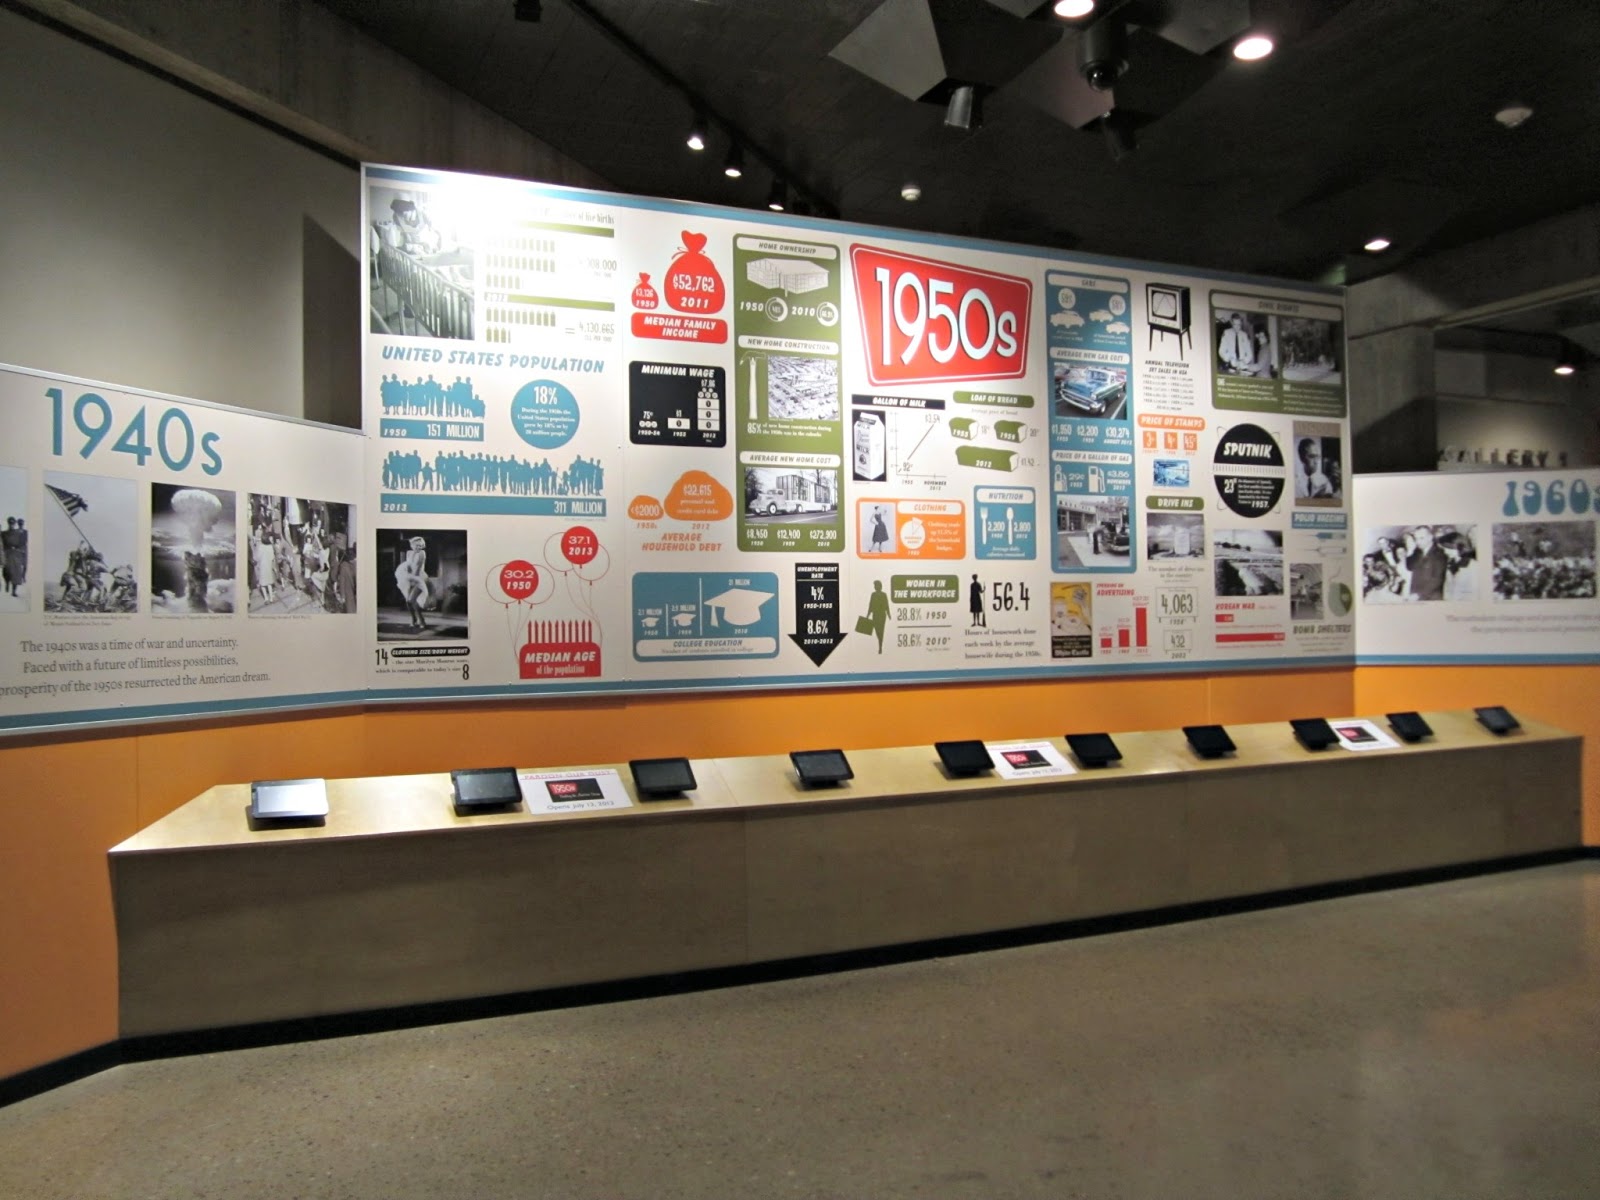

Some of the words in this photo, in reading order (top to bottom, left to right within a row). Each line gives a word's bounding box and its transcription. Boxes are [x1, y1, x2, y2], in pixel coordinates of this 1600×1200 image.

[597, 213, 614, 224] births
[759, 243, 777, 251] HOME
[780, 245, 816, 254] OWNERSHIP
[672, 274, 715, 293] $52,762
[635, 300, 655, 308] 1950
[681, 297, 709, 309] 2011
[740, 301, 764, 311] 1950
[791, 306, 816, 316] 2010
[875, 266, 1018, 366] 1950s
[644, 316, 682, 328] MEDIAN
[683, 319, 716, 330] FAMILY
[662, 328, 699, 339] INCOME
[784, 341, 830, 350] CONSTRUCTION
[382, 345, 443, 363] UNITED
[448, 350, 504, 367] STATES
[509, 355, 605, 373] POPULATION
[641, 365, 687, 376] MINIMUM
[689, 368, 715, 378] WAGE
[533, 385, 558, 405] 18%
[971, 394, 986, 402] LOAF
[997, 396, 1018, 404] BREAD
[872, 396, 898, 406] GALLON
[909, 400, 927, 408] MILK
[1141, 416, 1163, 425] PRICE
[1164, 417, 1174, 426] OF
[1174, 417, 1202, 427] STAMPS
[45, 387, 223, 476] 1940s
[383, 428, 408, 437] 1950
[427, 423, 441, 437] 151
[446, 424, 480, 438] MILLION
[1223, 442, 1273, 459] SPUTNIK
[750, 454, 778, 462] AVERAGE
[554, 501, 567, 514] 311
[571, 501, 603, 514] MILLION
[1157, 498, 1179, 507] DRIVE
[1180, 499, 1194, 508] INS
[568, 536, 591, 545] 37.1
[661, 533, 702, 542] AVERAGE
[568, 547, 593, 556] 2013
[641, 543, 696, 551] HOUSEHOLD
[699, 543, 722, 551] DEBT
[504, 570, 534, 579] 30.2
[506, 581, 532, 590] 1950
[906, 579, 935, 587] WOMEN
[937, 579, 946, 587] IN
[811, 586, 824, 600] 4%
[894, 589, 908, 598] THE
[910, 589, 956, 598] WORKFORCE
[992, 581, 1030, 611] 56.4
[1161, 593, 1193, 615] 4,063
[897, 607, 922, 621] 28.8%
[926, 611, 947, 620] 1950
[807, 619, 829, 635] 8.6%
[20, 640, 43, 653] The
[46, 641, 77, 655] 1940s
[79, 641, 100, 651] was
[101, 641, 107, 651] a
[109, 639, 133, 650] time
[134, 638, 146, 650] of
[146, 640, 166, 649] war
[166, 638, 184, 649] and
[185, 637, 239, 650] uncertainty.
[704, 639, 743, 647] EDUCATION
[897, 633, 921, 647] 58.6%
[375, 648, 388, 665] 14
[524, 652, 571, 663] MEDIAN
[573, 651, 596, 662] AGE
[995, 651, 1013, 659] during
[23, 660, 57, 673] Faced
[58, 660, 83, 672] with
[85, 662, 92, 671] a
[93, 658, 127, 671] future
[128, 657, 140, 669] of
[140, 656, 181, 669] limitless
[183, 655, 239, 670] possibilities,
[536, 665, 542, 674] of
[544, 665, 553, 674] the
[554, 664, 585, 676] population
[462, 664, 470, 680] 8
[0, 682, 59, 699] prosperity
[60, 680, 73, 692] of
[74, 679, 92, 692] the
[94, 680, 122, 693] 1950s
[124, 675, 181, 689] resurrected
[182, 674, 197, 685] the
[199, 673, 241, 685] American
[242, 671, 271, 682] dream.
[552, 783, 576, 793] 1950s
